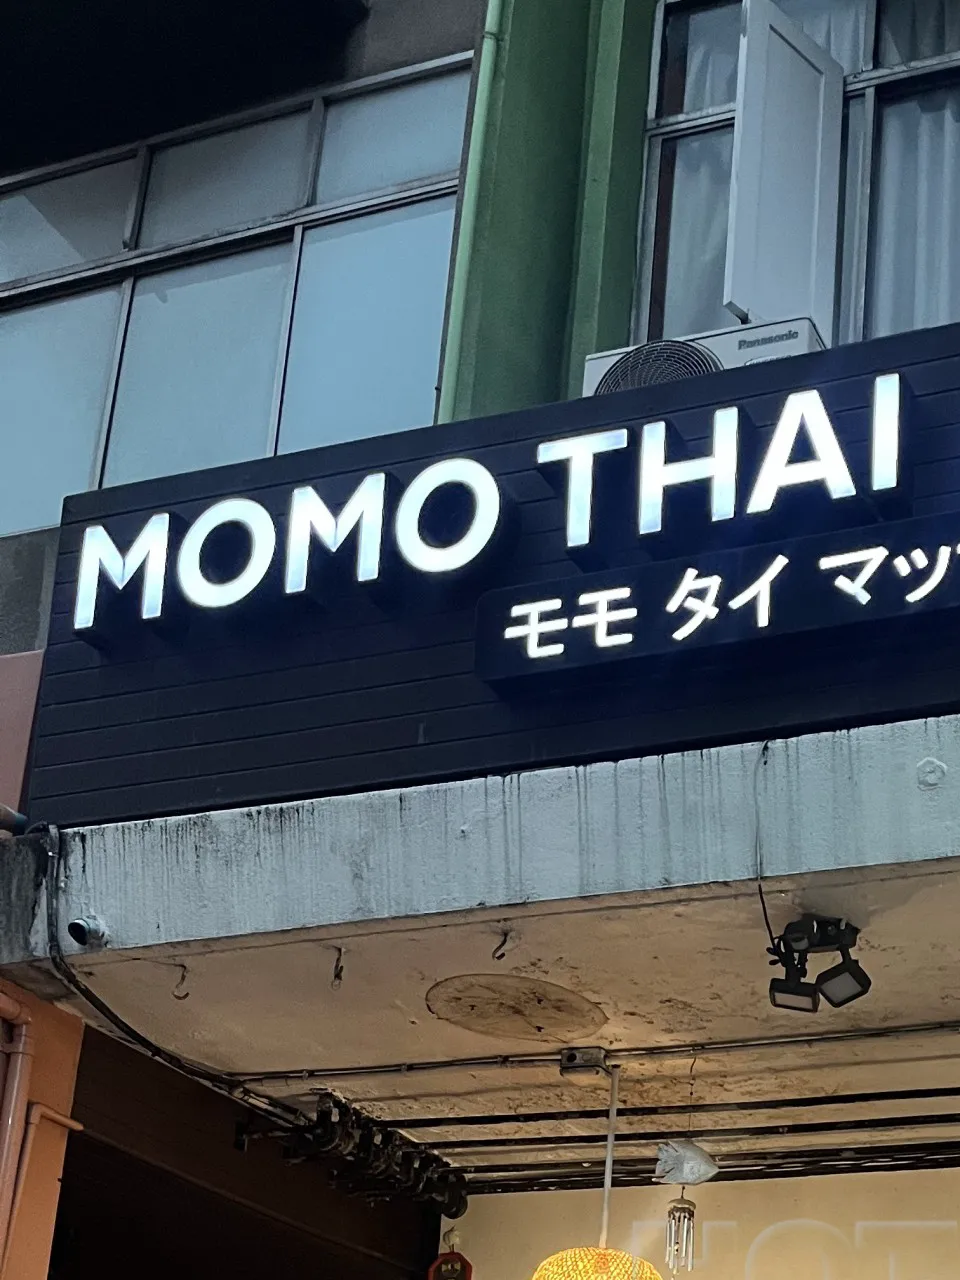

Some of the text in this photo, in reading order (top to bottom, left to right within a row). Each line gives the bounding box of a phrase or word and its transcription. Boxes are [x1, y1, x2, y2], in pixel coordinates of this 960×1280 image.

[737, 330, 799, 350] Panasonic
[73, 456, 501, 630] MOMO
[537, 372, 900, 549] THAI
[504, 587, 638, 659] モモ
[666, 554, 792, 641] タイ
